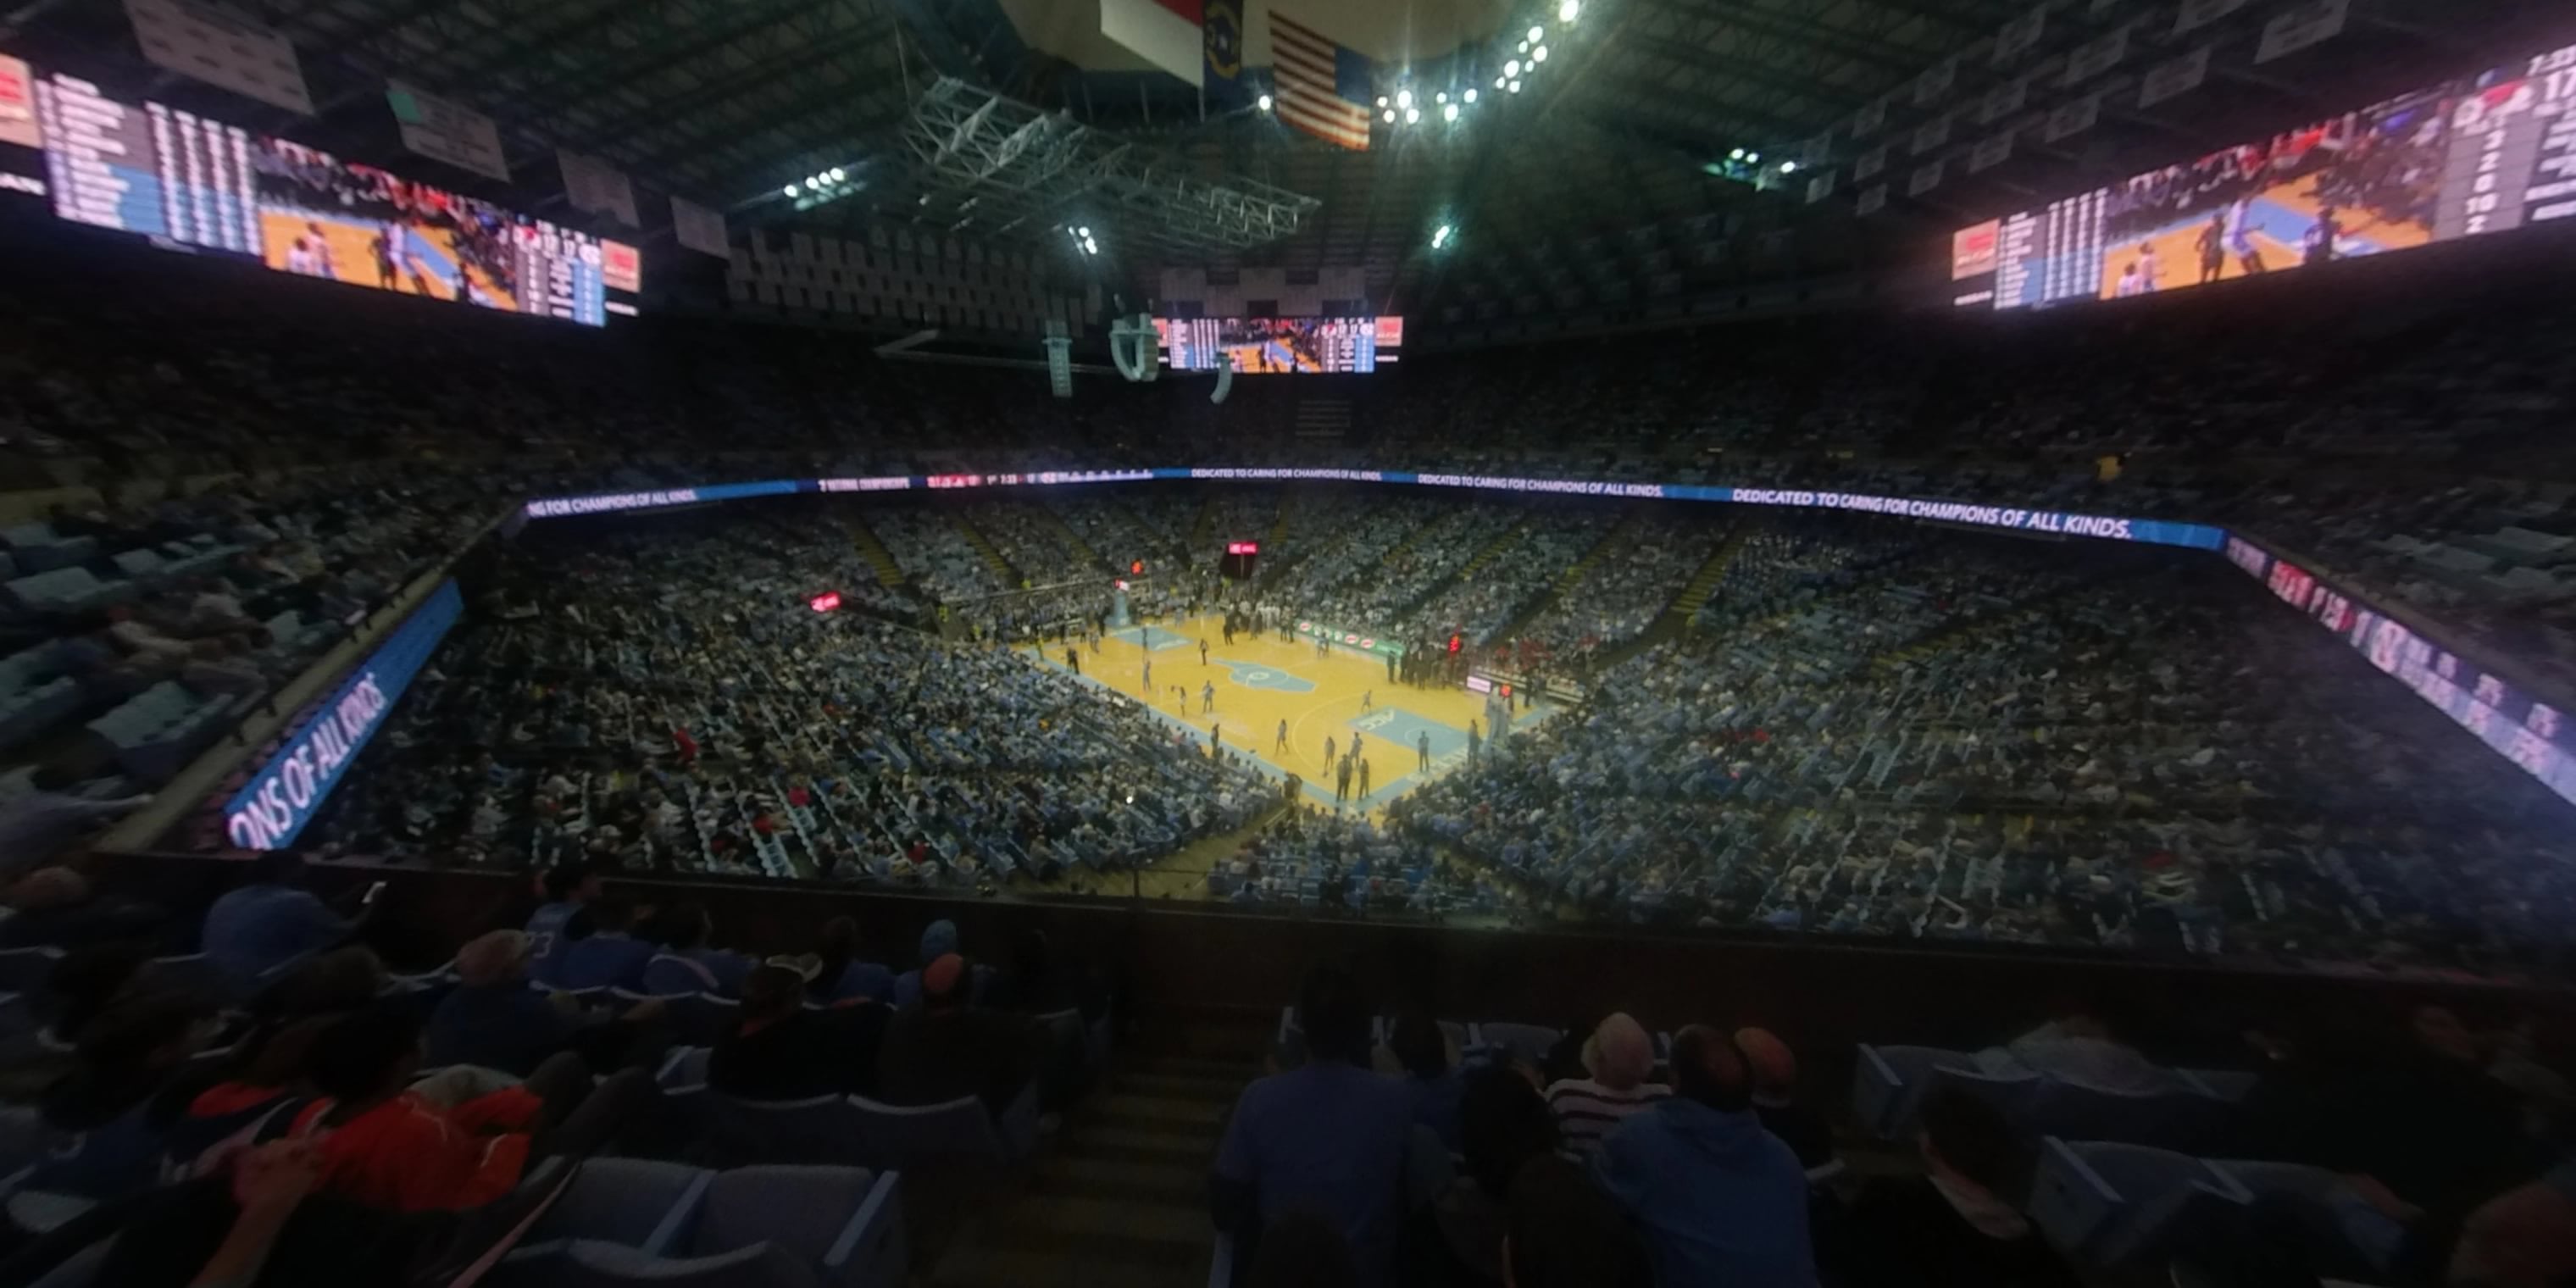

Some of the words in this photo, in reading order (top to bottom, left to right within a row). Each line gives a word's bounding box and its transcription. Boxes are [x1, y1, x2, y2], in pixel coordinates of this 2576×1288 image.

[1191, 469, 1234, 478] DEDICATED
[1235, 469, 1246, 478] TO
[1246, 469, 1277, 479] CARING
[1278, 469, 1292, 479] FOR
[1293, 469, 1340, 480] CHAMPIONS
[1341, 471, 1349, 480] OF
[1349, 472, 1360, 480] ALL
[1418, 474, 1460, 486] DEDICATED
[1462, 476, 1473, 486] TO
[1474, 476, 1507, 489] CARING
[1508, 479, 1526, 490] FOR
[1527, 480, 1586, 493] CHAMPIONS
[1588, 483, 1602, 494] OF
[1604, 484, 1624, 496] ALL
[1626, 485, 1663, 497] KINDS.
[546, 500, 572, 514] FOR
[571, 493, 637, 513] CHAMPIONS
[637, 492, 650, 507] OF
[651, 491, 669, 506] ALL
[1733, 489, 1814, 506] DEDICATED
[1816, 493, 1839, 507] TO
[1839, 494, 1884, 512] CARING
[1882, 498, 1910, 514] FOR
[1909, 500, 2000, 525] CHAMPIONS
[2000, 509, 2026, 528] OF
[2025, 512, 2060, 531] ALL
[2063, 515, 2133, 540] KINDS.
[283, 744, 317, 809] OF
[310, 715, 351, 780] ALL
